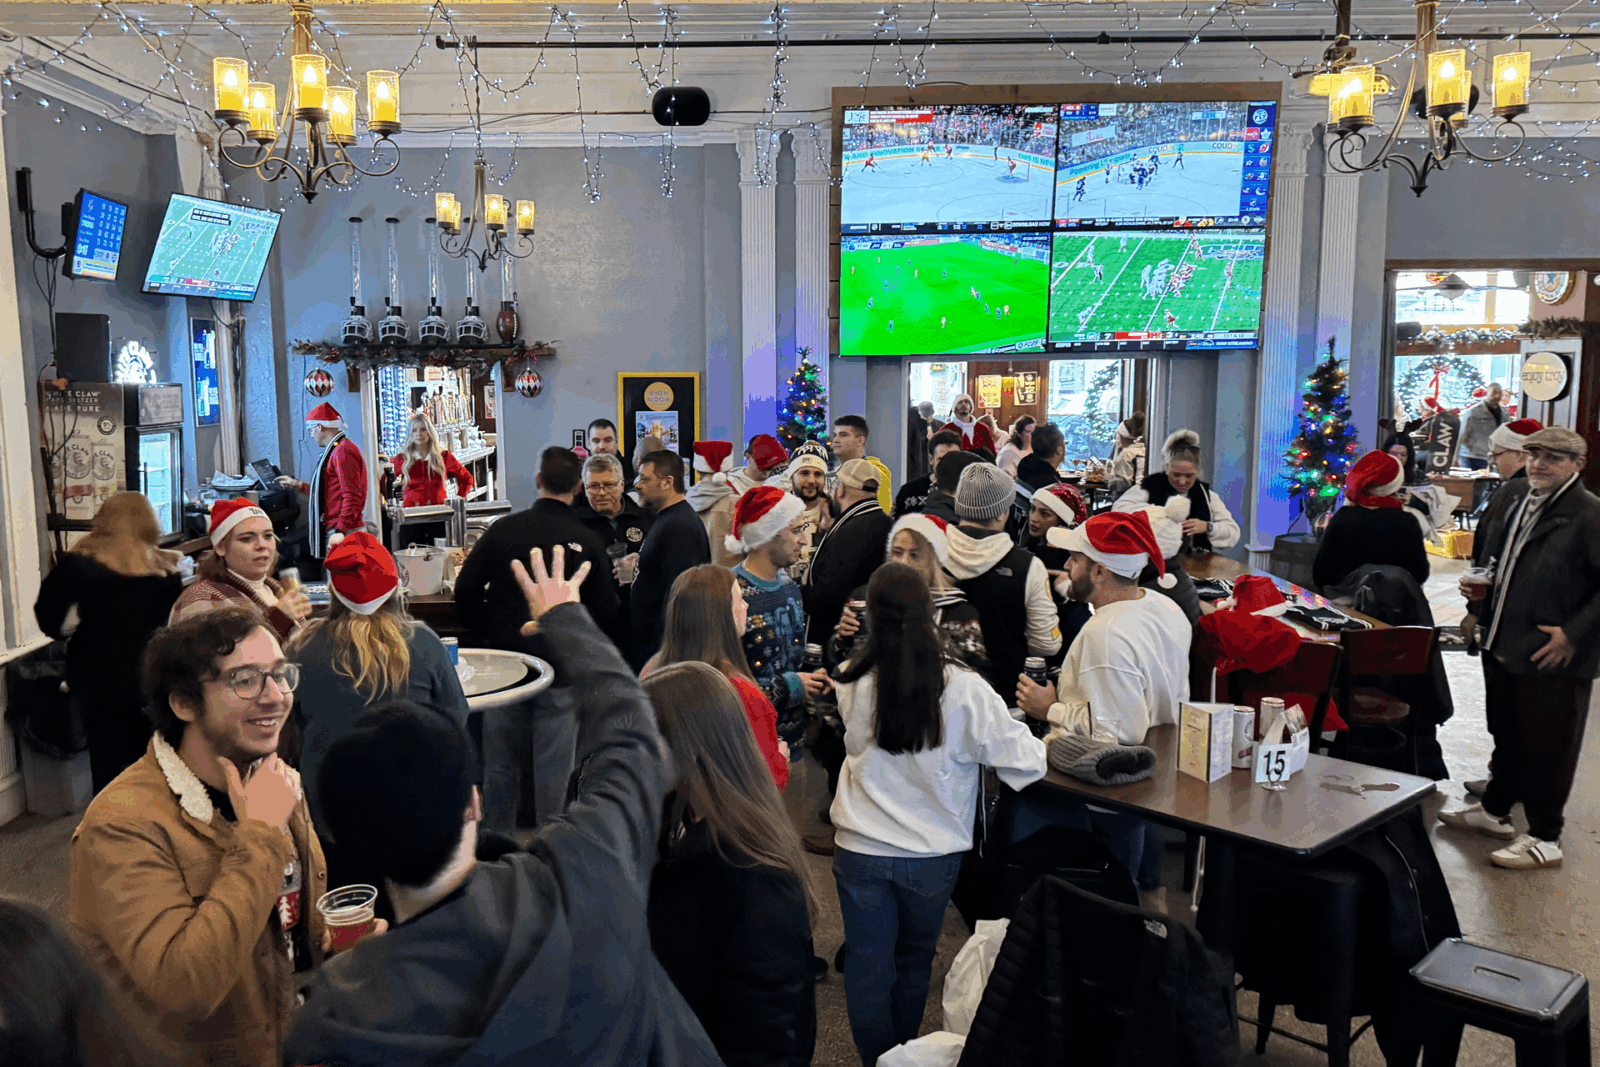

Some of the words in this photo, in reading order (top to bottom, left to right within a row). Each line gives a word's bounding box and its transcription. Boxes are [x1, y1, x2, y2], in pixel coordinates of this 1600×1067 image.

[1522, 371, 1544, 384] enjoy
[1545, 371, 1565, 384] troy
[1433, 421, 1454, 468] CLAW
[1263, 750, 1286, 775] 15
